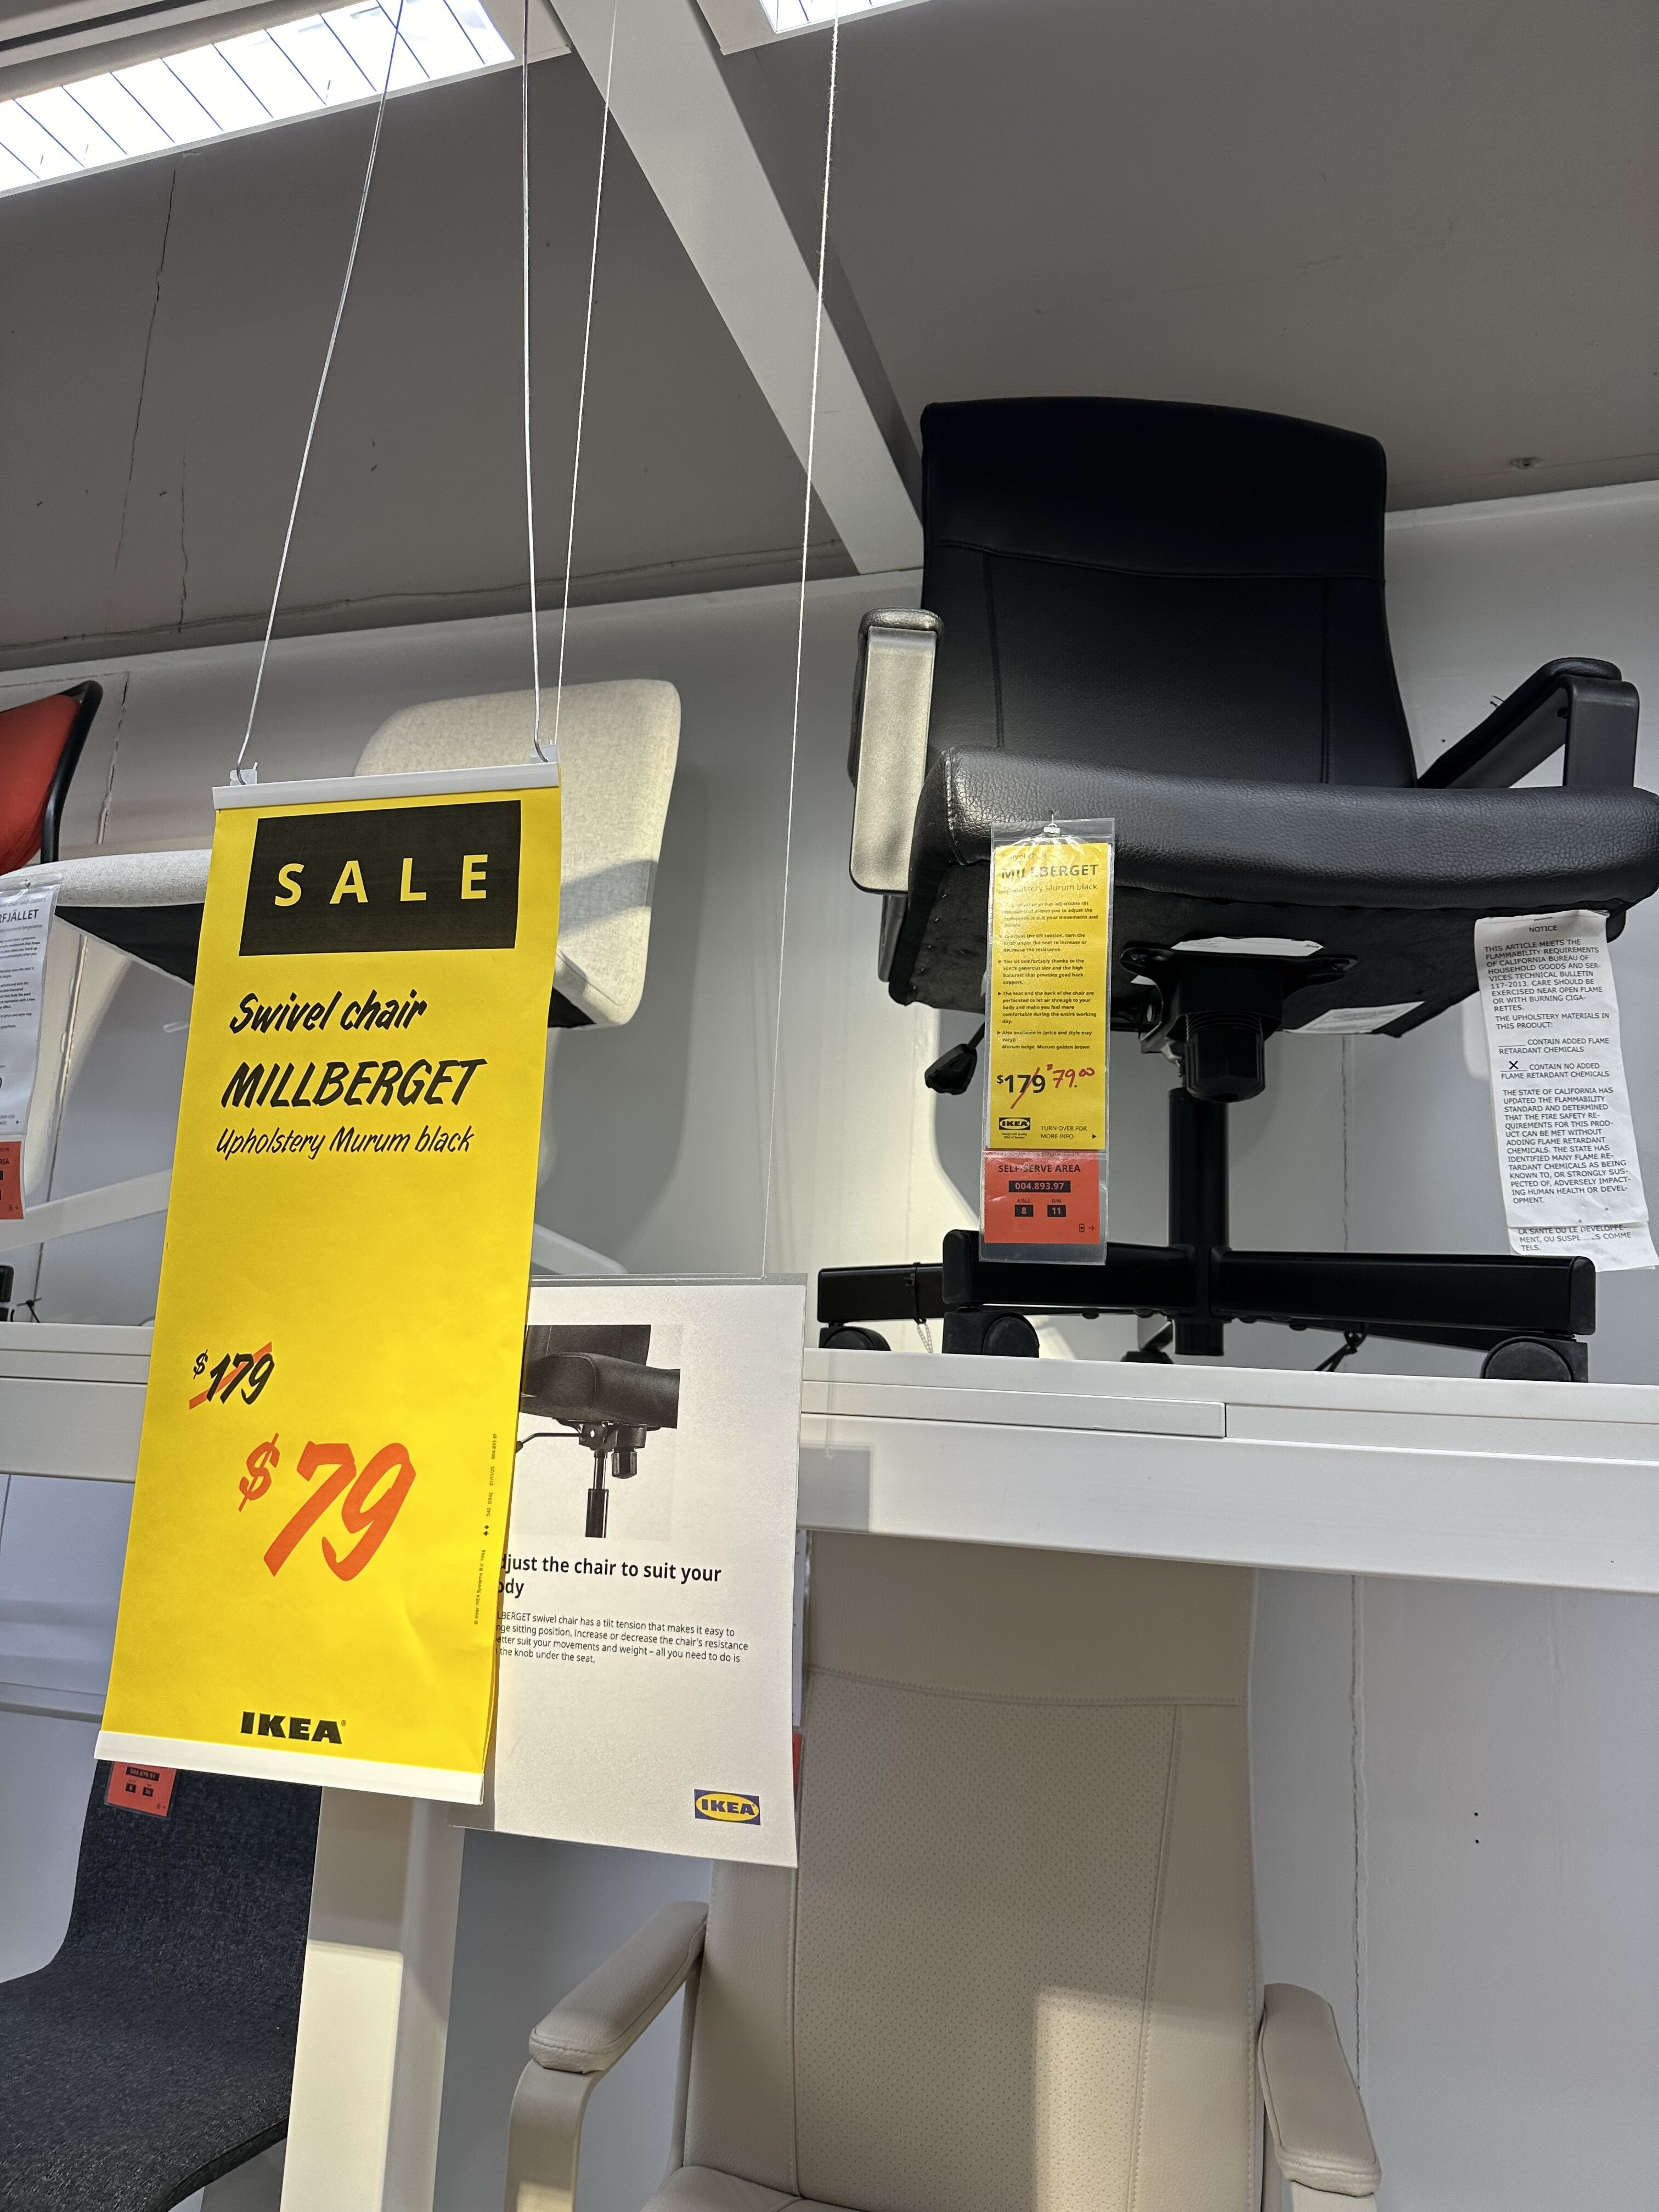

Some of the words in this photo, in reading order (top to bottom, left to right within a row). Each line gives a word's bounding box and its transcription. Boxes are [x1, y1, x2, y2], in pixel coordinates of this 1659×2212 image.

[274, 854, 488, 906] SALE
[1486, 949, 1541, 960] FLAMMABILITY
[1505, 942, 1537, 951] ARTICLE
[1488, 964, 1536, 974] HOUSEHOLD
[1500, 956, 1546, 966] CALIFORNIA
[1491, 981, 1528, 989] 117-2013.
[229, 990, 342, 1034] Swivel
[340, 989, 428, 1032] chair
[221, 1059, 488, 1108] MILLBERGET
[217, 1127, 326, 1160] Upholstery
[329, 1126, 412, 1153] Murum
[415, 1125, 475, 1153] black
[500, 1554, 538, 1574] djust
[543, 1556, 569, 1573] the
[574, 1558, 616, 1576] chair
[621, 1561, 639, 1577] to
[644, 1562, 676, 1579] suit
[681, 1566, 722, 1584] your
[498, 1578, 524, 1599] ody
[496, 1624, 510, 1633] nge
[512, 1624, 537, 1637] sitting
[539, 1626, 573, 1639] position.
[574, 1628, 608, 1640] Increase
[610, 1632, 619, 1640] or
[621, 1630, 658, 1643] decrease
[659, 1633, 674, 1644] the
[675, 1635, 703, 1647] chair's
[705, 1639, 748, 1650] resistance
[497, 1611, 531, 1621] LBERGET
[533, 1614, 556, 1624] swivel
[558, 1615, 578, 1626] chair
[580, 1617, 594, 1627] has
[603, 1618, 614, 1628] tilt
[616, 1620, 646, 1630] tension
[648, 1622, 665, 1632] that
[667, 1624, 695, 1634] makes
[696, 1625, 703, 1634] it
[704, 1627, 724, 1638] easy
[726, 1628, 735, 1637] to
[496, 1636, 515, 1644] etter
[517, 1636, 532, 1646] suit
[533, 1640, 551, 1649] your
[553, 1640, 600, 1651] movements
[601, 1643, 617, 1653] and
[619, 1644, 648, 1657] weight
[656, 1647, 665, 1656] all
[667, 1649, 683, 1660] you
[685, 1650, 707, 1661] need
[708, 1651, 718, 1661] to
[720, 1652, 731, 1662] do
[733, 1654, 740, 1662] is
[500, 1647, 512, 1657] the
[514, 1647, 534, 1658] knob
[536, 1649, 560, 1661] under
[561, 1651, 575, 1661] the
[577, 1654, 596, 1663] seat.
